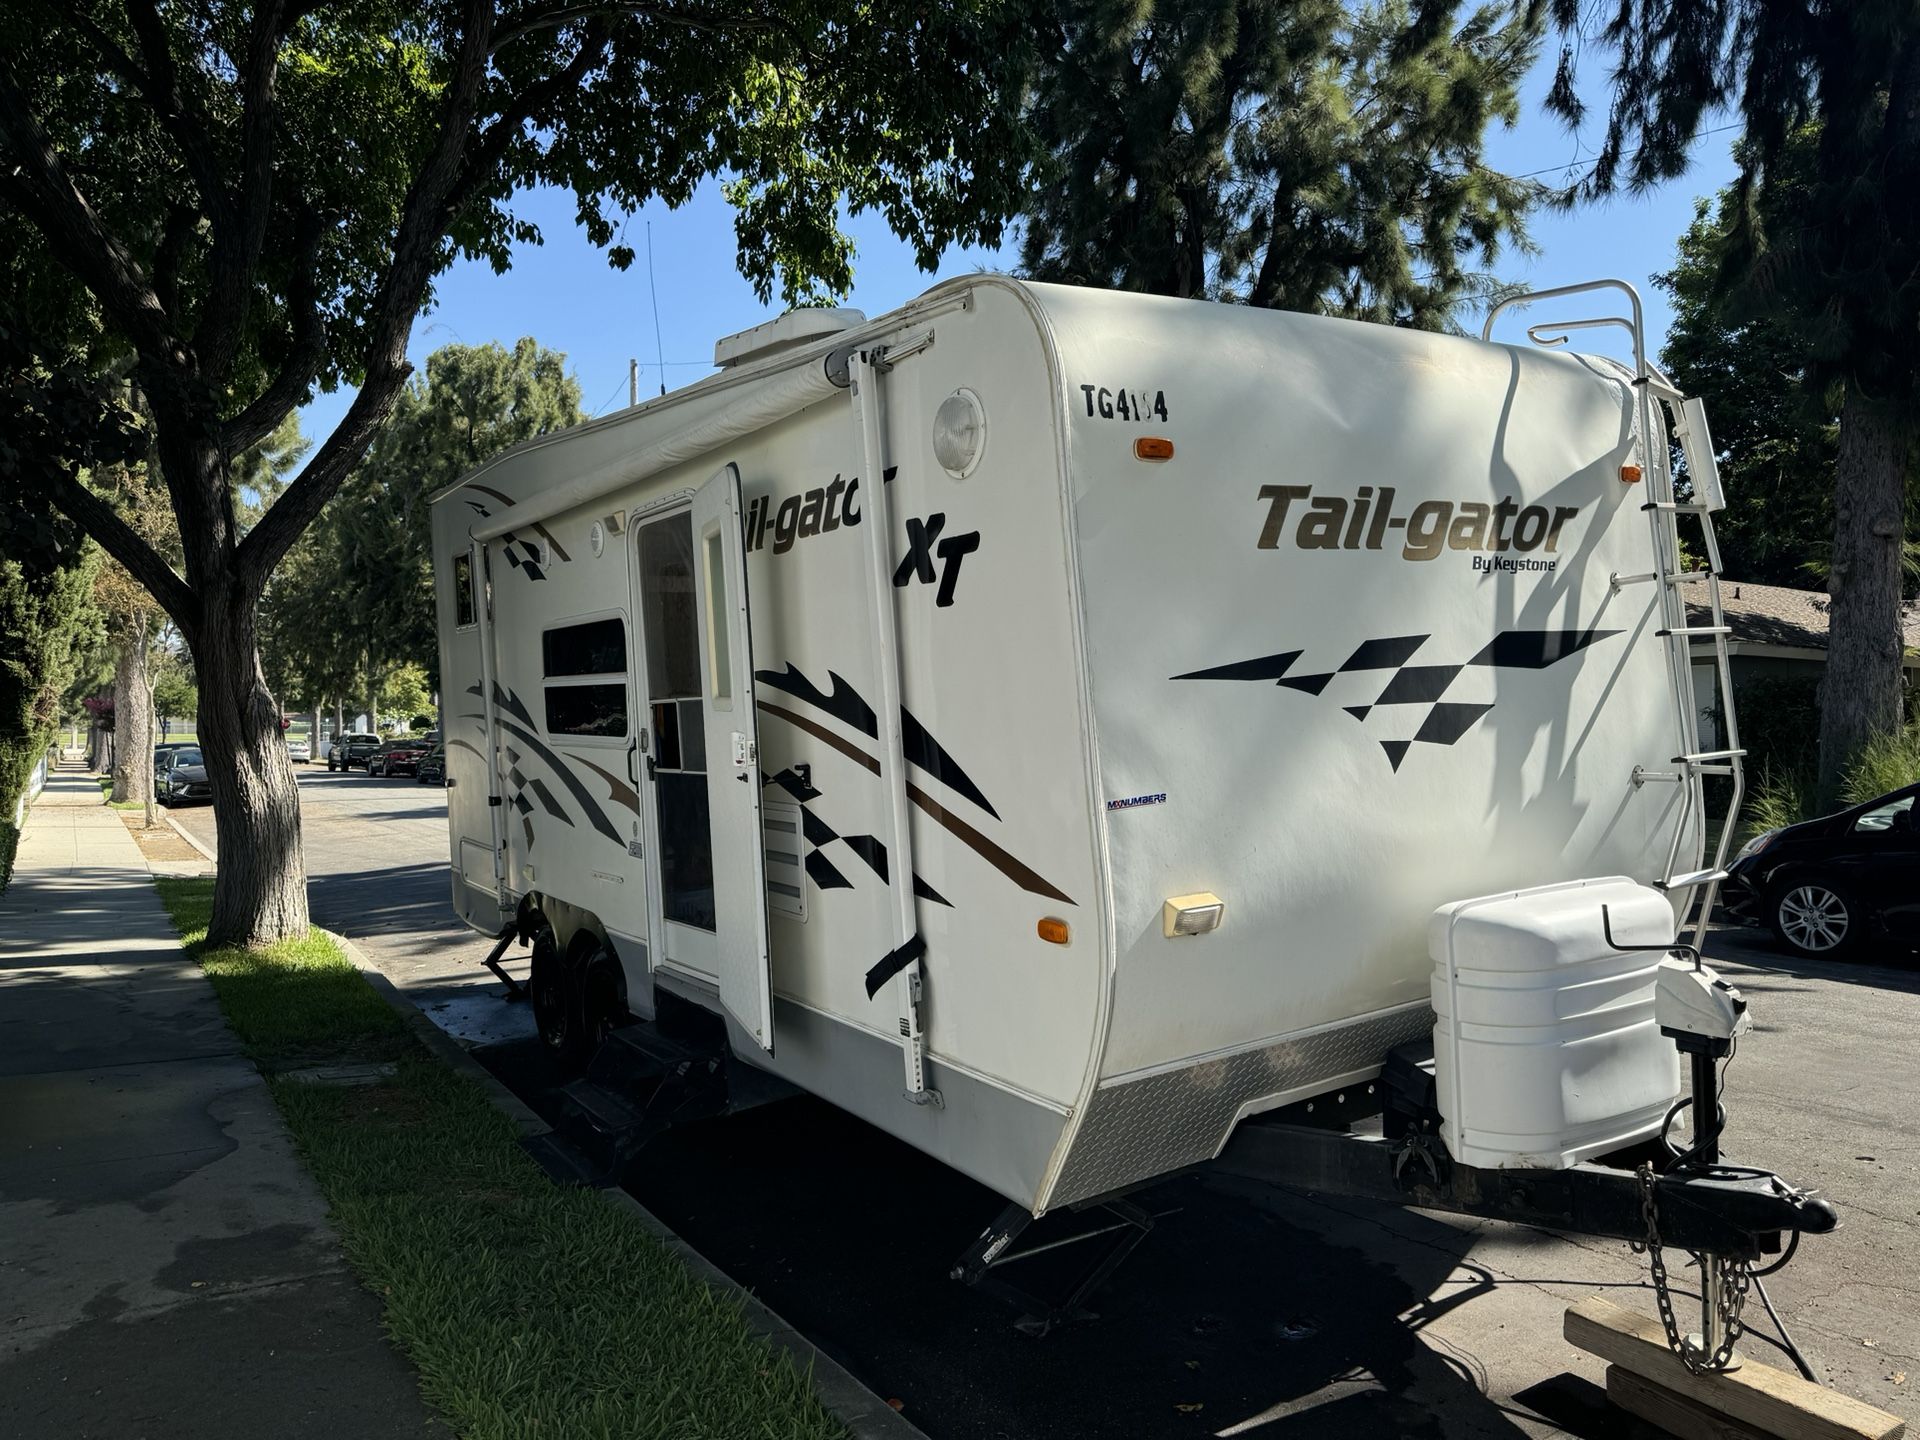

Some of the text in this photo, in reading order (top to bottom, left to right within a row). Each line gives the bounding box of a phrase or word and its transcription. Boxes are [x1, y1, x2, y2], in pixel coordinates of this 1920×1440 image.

[893, 512, 980, 607] XT
[1257, 484, 1579, 561] Tail-gator
[1472, 555, 1556, 574] By Keystone
